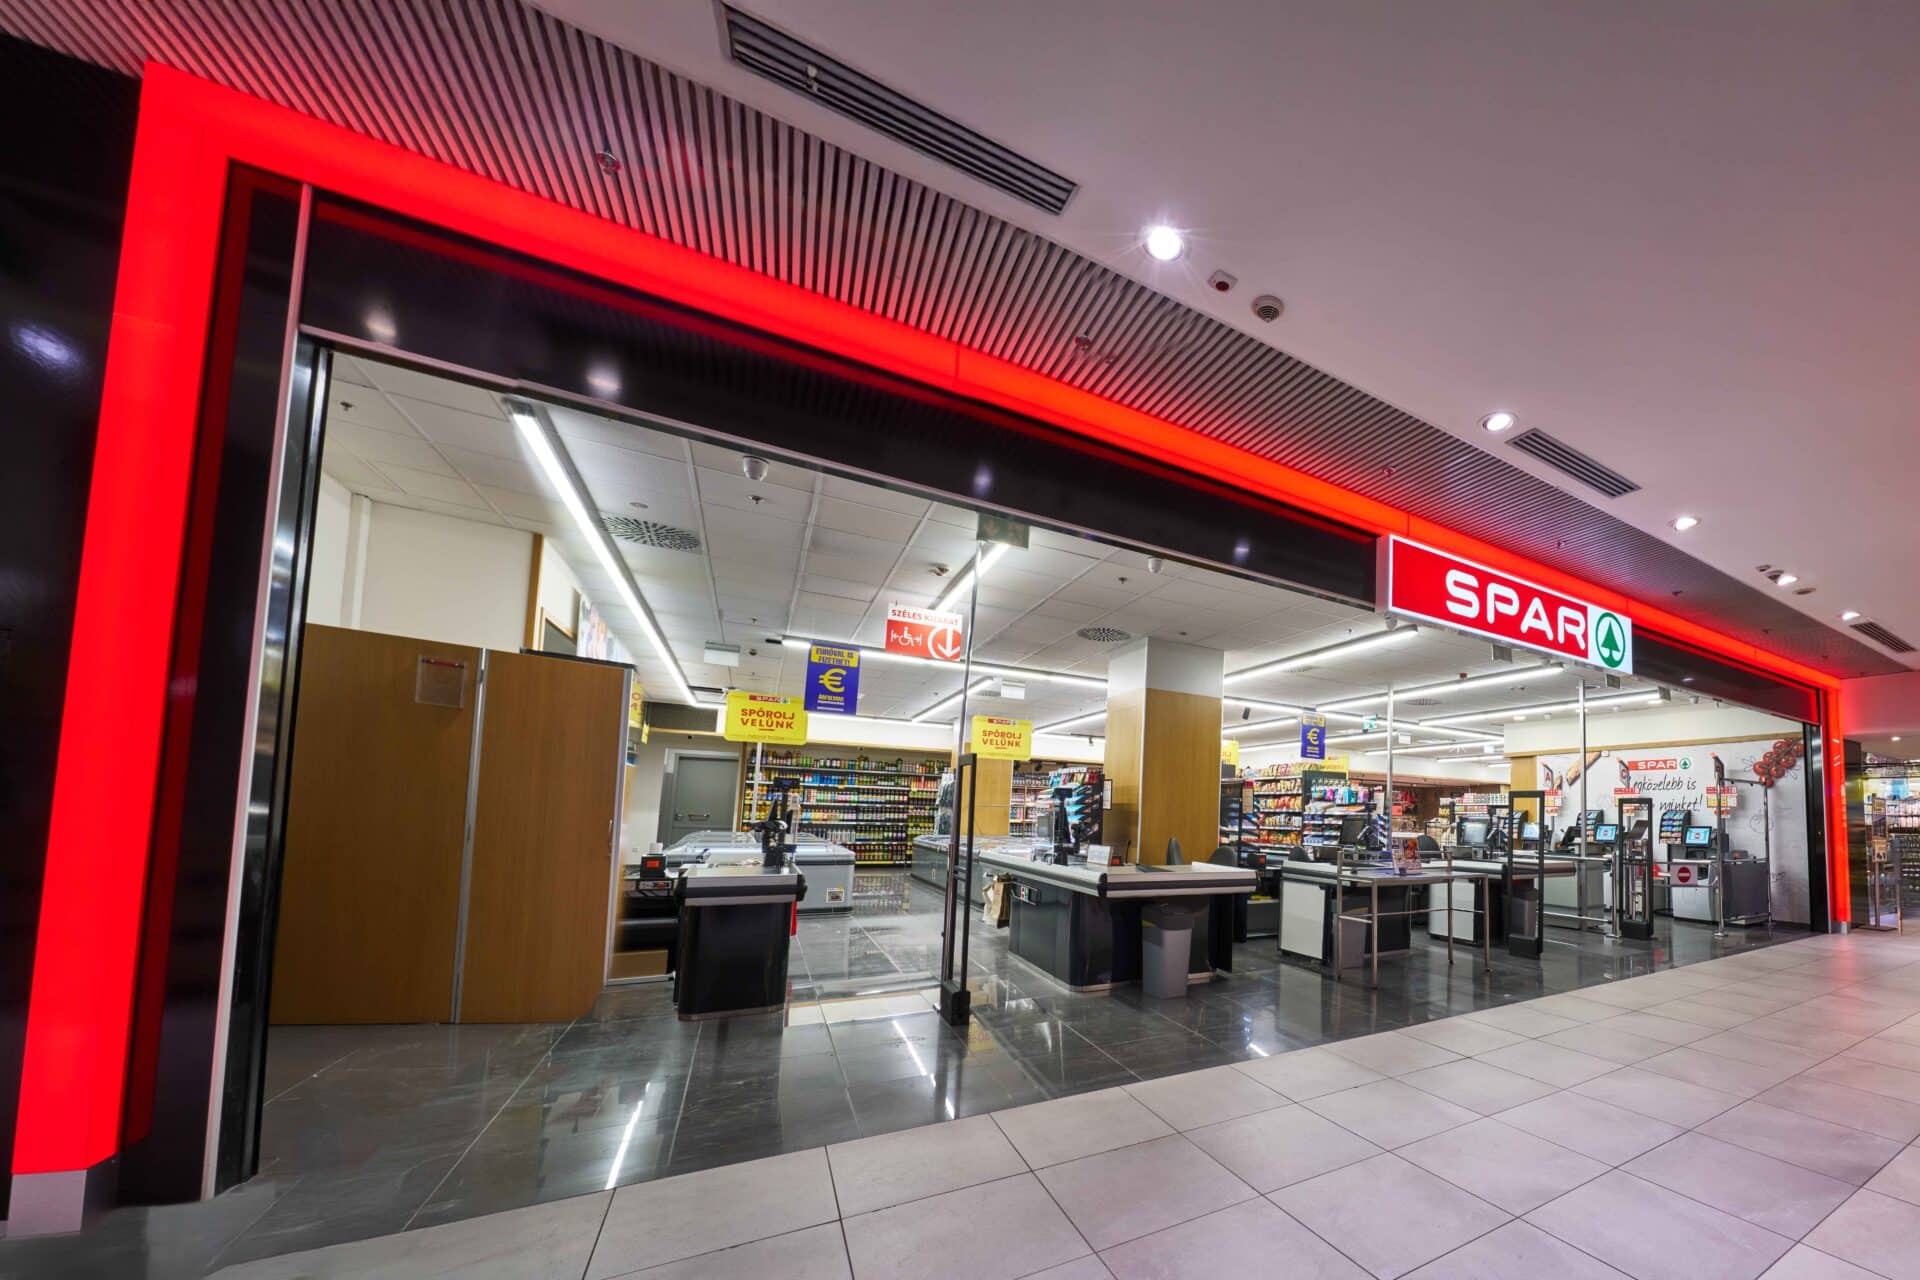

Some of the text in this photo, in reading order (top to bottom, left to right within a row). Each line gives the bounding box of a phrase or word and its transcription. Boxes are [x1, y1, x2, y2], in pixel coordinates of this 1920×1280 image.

[1445, 568, 1586, 650] SPAR
[741, 707, 795, 720] SPÓROLJ
[740, 717, 794, 729] VELÜNK
[1637, 760, 1677, 769] SPAR
[1630, 773, 1683, 792] egközelebb
